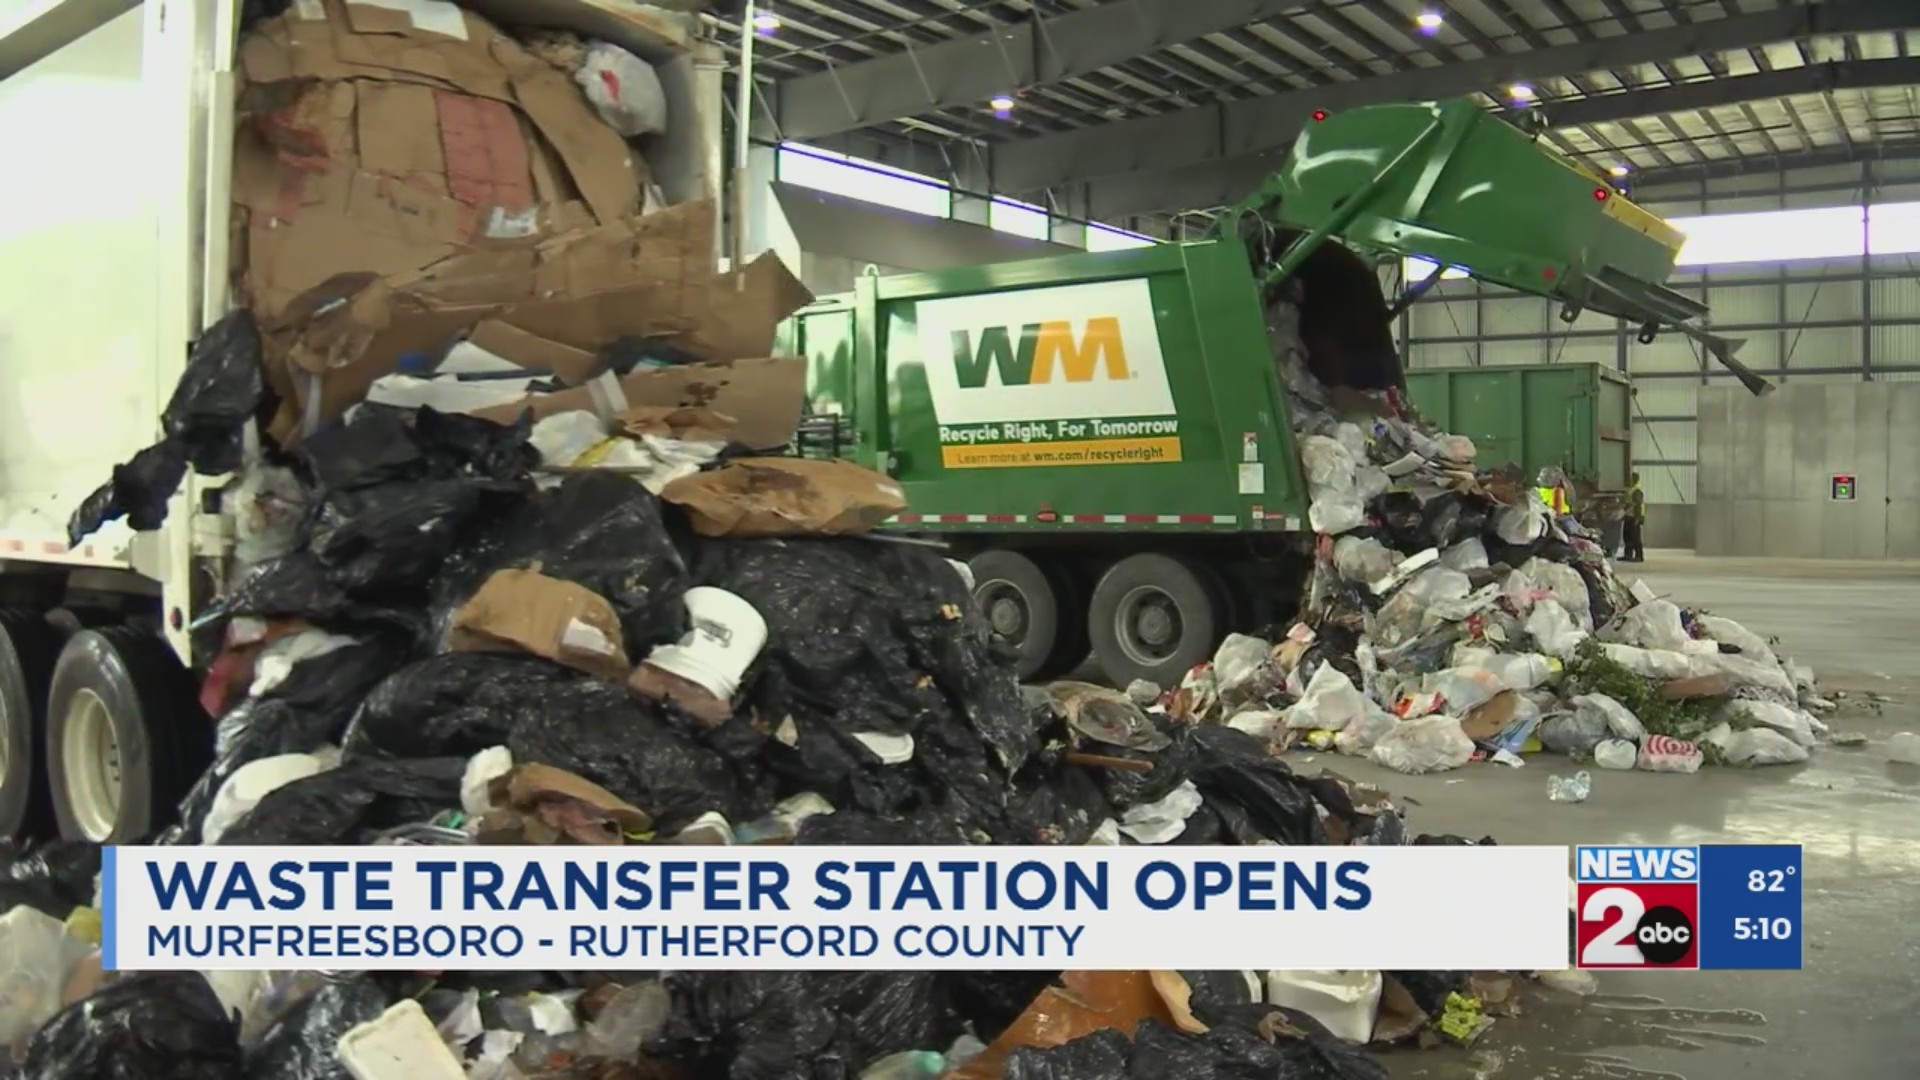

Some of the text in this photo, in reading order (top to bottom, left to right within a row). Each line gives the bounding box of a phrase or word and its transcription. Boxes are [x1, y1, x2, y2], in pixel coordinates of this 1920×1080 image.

[951, 317, 1130, 389] WM
[939, 420, 1178, 445] Recycle Right, For Tomorrow
[957, 446, 1164, 465] Learn more at wm.com/recycleright
